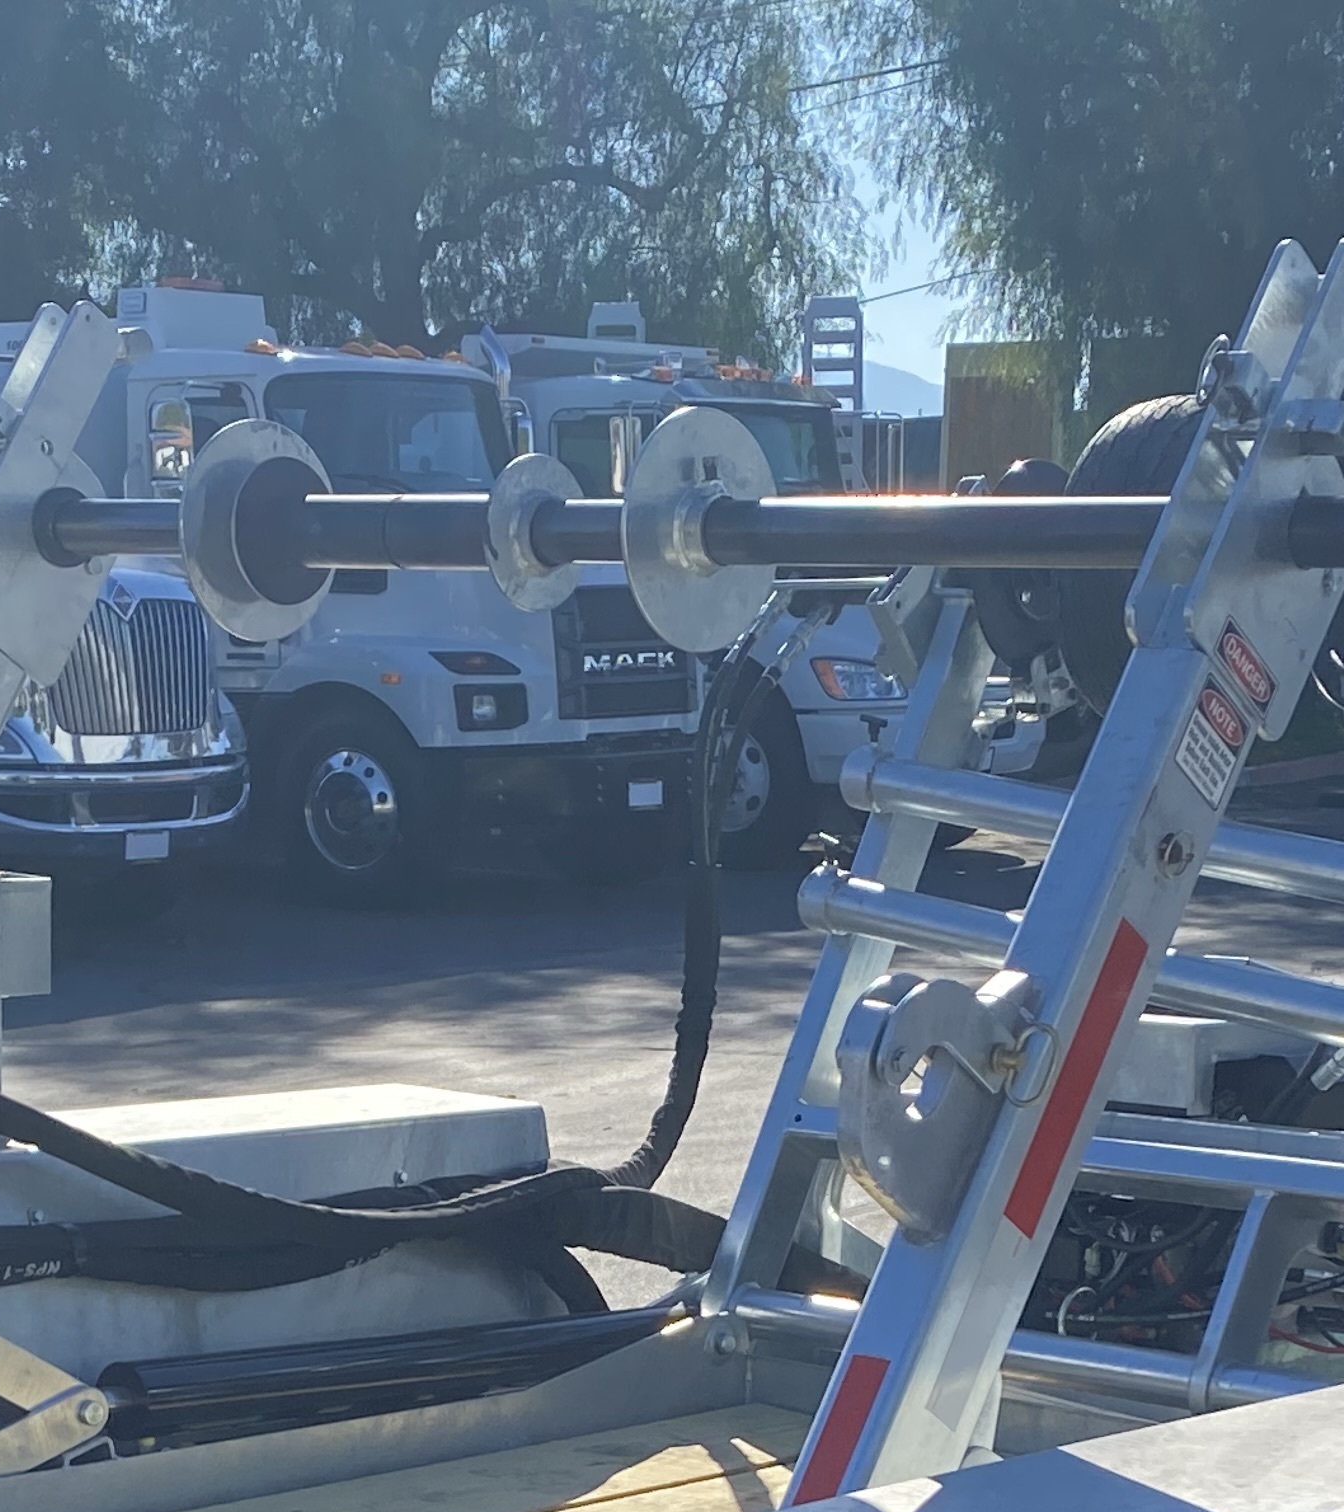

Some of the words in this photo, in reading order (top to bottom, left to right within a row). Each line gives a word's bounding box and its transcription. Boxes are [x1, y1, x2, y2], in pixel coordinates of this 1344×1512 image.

[583, 651, 676, 672] MACK
[1225, 637, 1268, 699] DANGER
[1208, 696, 1238, 738] NOTE
